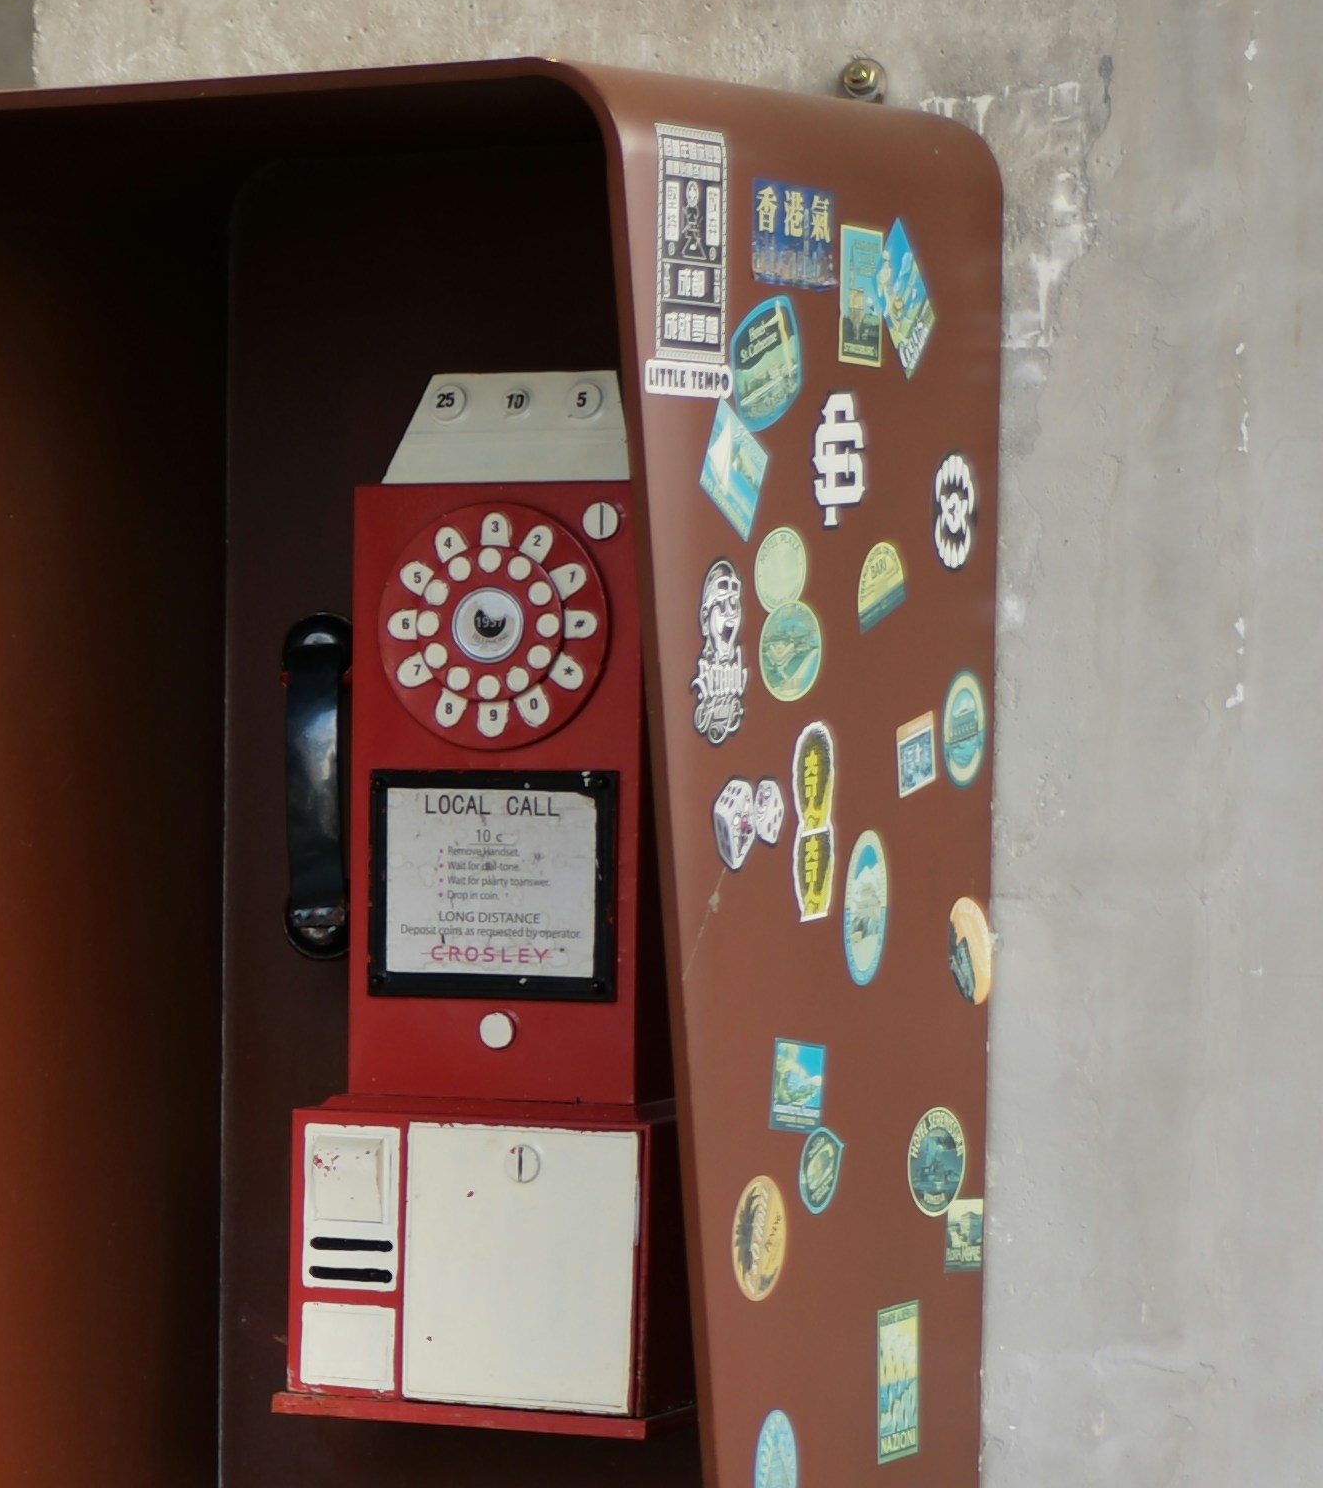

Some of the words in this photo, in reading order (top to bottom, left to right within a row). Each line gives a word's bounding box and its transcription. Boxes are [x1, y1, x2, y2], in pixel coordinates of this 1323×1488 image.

[756, 186, 831, 243] 香港氣
[677, 268, 705, 297] 成都
[649, 367, 686, 388] LITTLE
[691, 370, 729, 391] TEMPO
[436, 392, 455, 408] 25
[507, 393, 524, 409] 10
[576, 392, 587, 407] 5
[491, 521, 499, 532] 3
[443, 537, 452, 549] 4
[533, 535, 541, 546] 2
[413, 572, 422, 583] 5
[569, 571, 576, 582] 1
[402, 618, 409, 629] 6
[413, 664, 422, 676] 7
[445, 703, 453, 714] 8
[530, 698, 538, 709] 0
[490, 710, 498, 721] 9
[425, 794, 491, 814] LOCAL
[506, 796, 560, 817] CALL
[476, 830, 490, 843] 10
[496, 833, 503, 843] c
[448, 846, 482, 856] Remove
[448, 861, 466, 870] Wait
[468, 861, 480, 870] for
[448, 876, 466, 885] Wait
[468, 875, 480, 885] for
[448, 890, 468, 901] Drop
[470, 891, 478, 899] in
[480, 891, 499, 900] coin.
[439, 912, 475, 923] LONG
[478, 912, 541, 924] DISTANCE
[401, 924, 436, 936] Deposit
[439, 926, 463, 935] coins
[465, 928, 475, 936] as
[477, 928, 524, 938] requested
[526, 928, 537, 939] by
[539, 930, 581, 941] operator.
[431, 946, 549, 963] CROSLEY
[880, 1428, 916, 1454] NAZIONI
